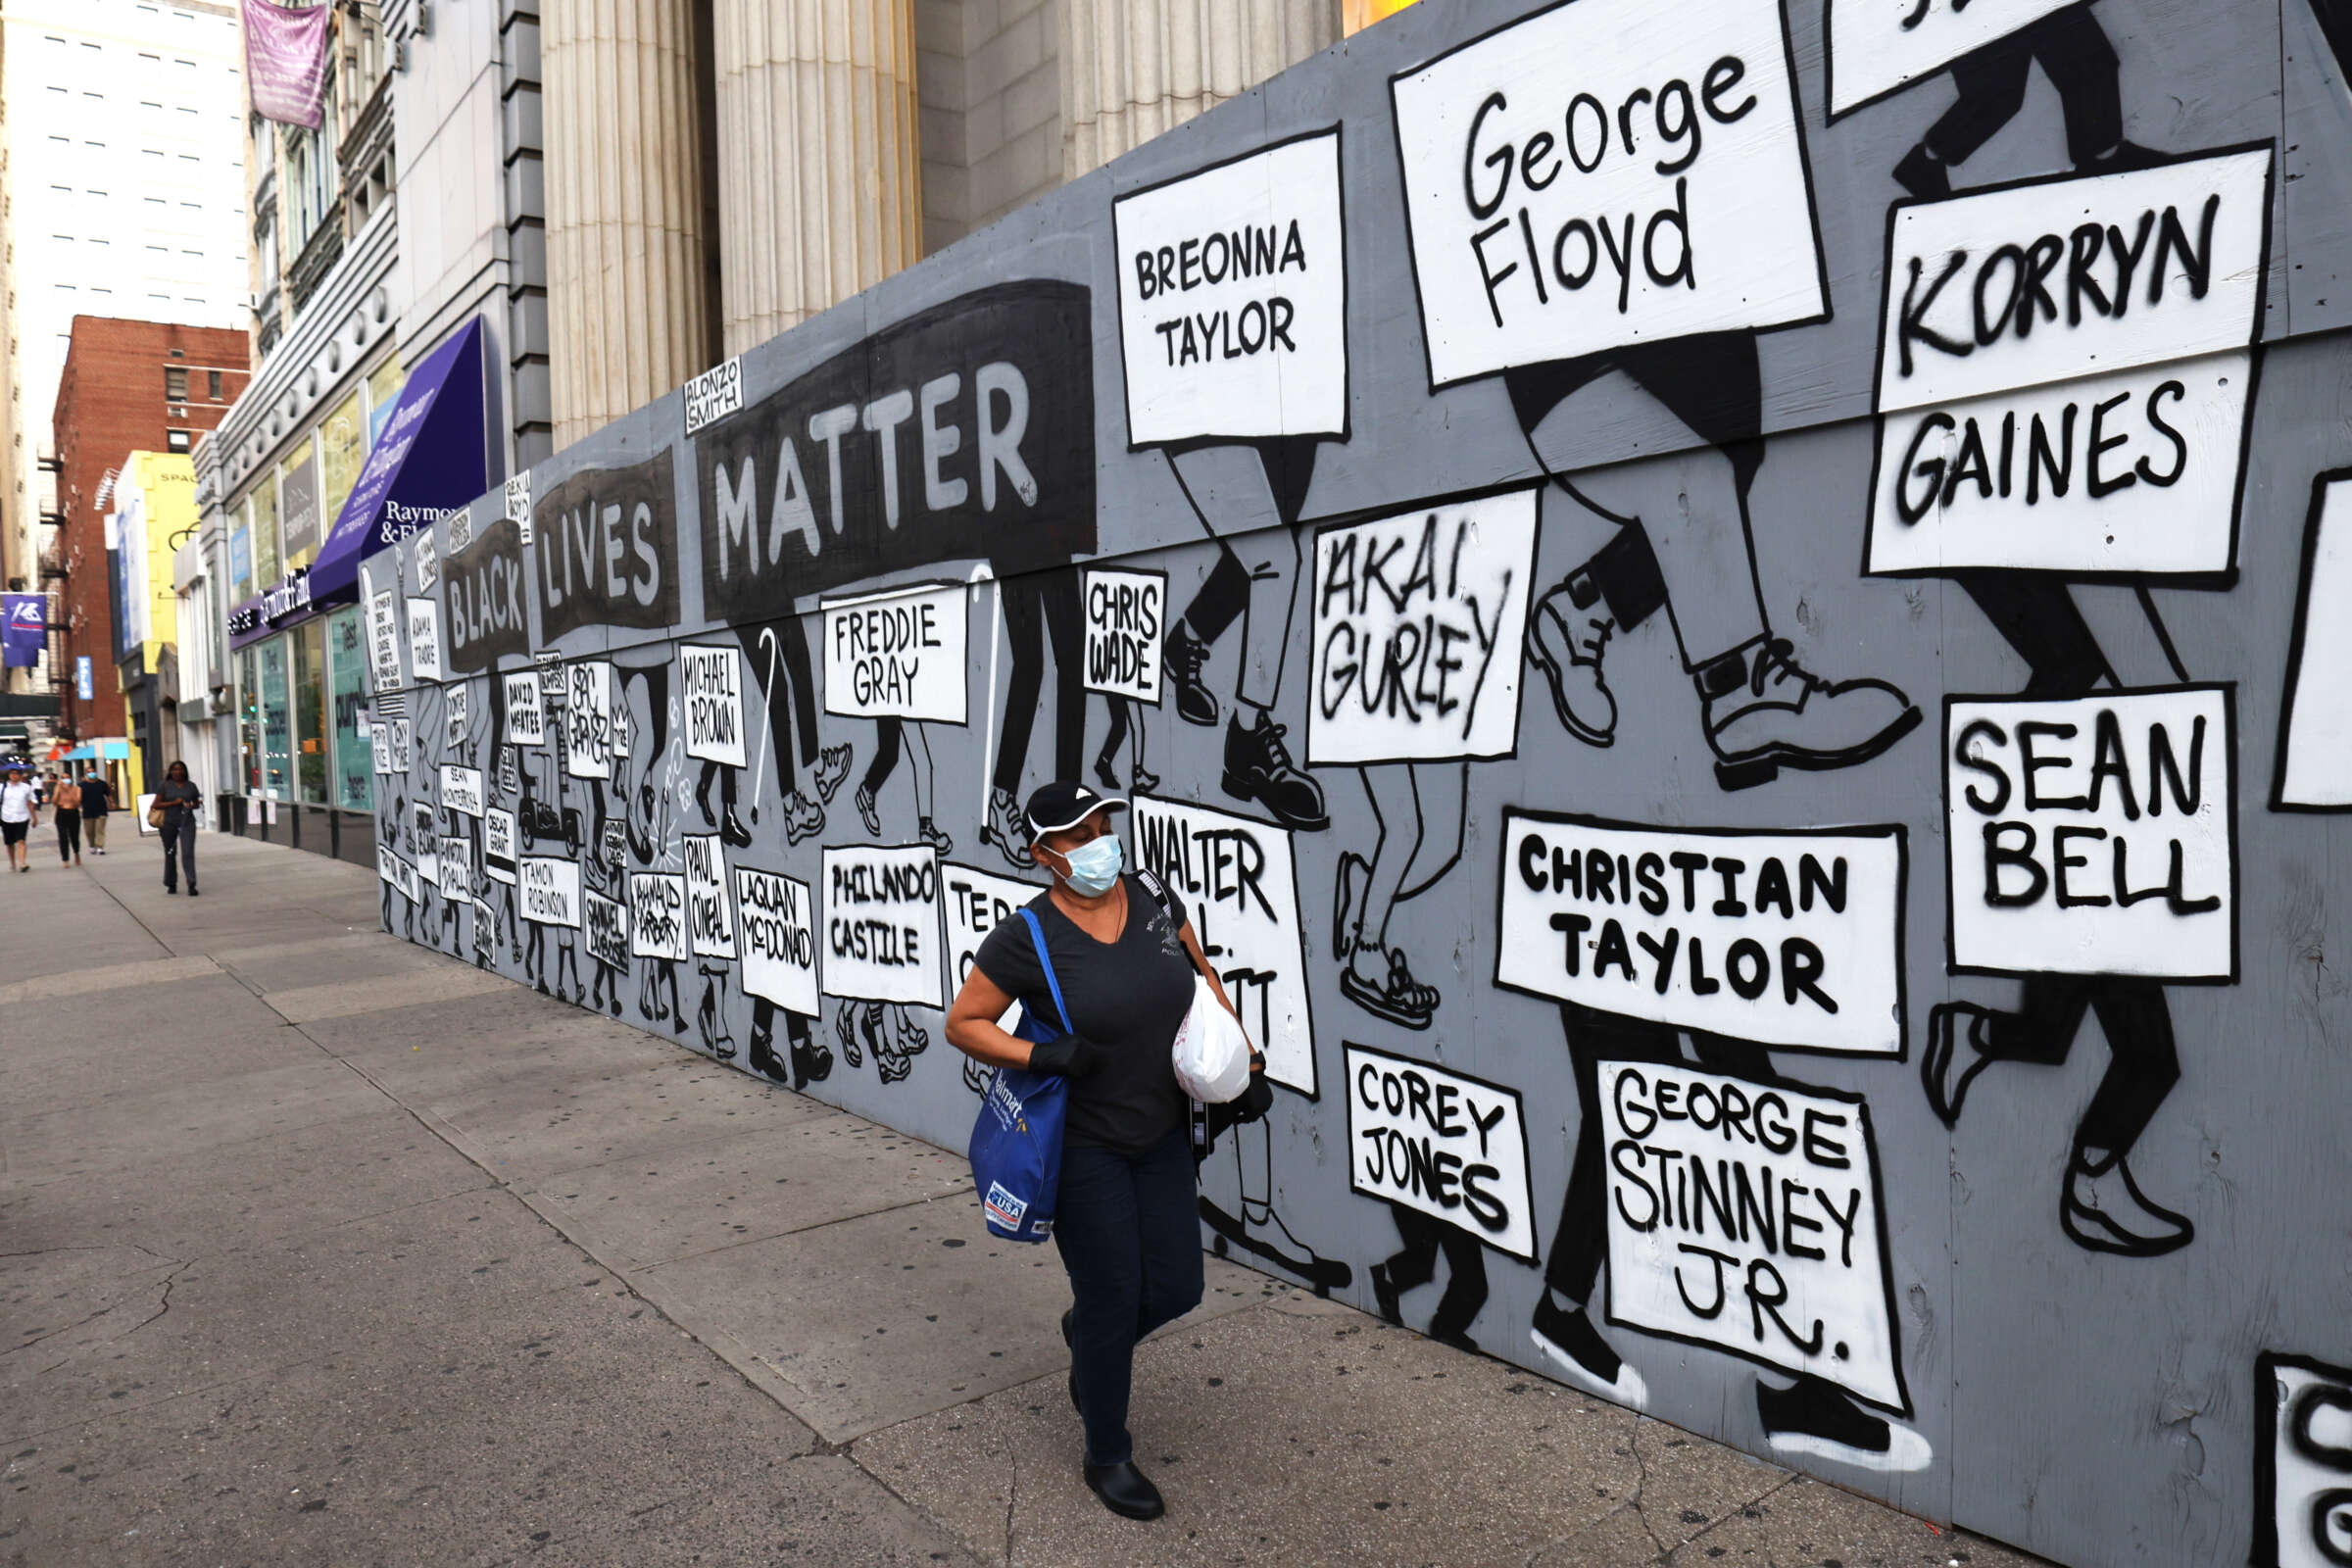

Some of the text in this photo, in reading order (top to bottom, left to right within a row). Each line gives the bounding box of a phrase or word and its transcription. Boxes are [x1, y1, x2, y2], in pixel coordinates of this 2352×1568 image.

[1463, 55, 1757, 220] George
[1136, 218, 1307, 301] BREONNA
[1471, 176, 1696, 327] Floyd
[1899, 193, 2221, 378] KORRYN
[1155, 297, 1296, 368] TAYLOR
[687, 362, 737, 407] ALONZO
[688, 386, 737, 429] SMITH
[714, 361, 1038, 583] MATTER
[1895, 379, 2185, 527] GAINES
[385, 501, 457, 524] Raymo
[543, 500, 660, 608] LIVES
[1322, 514, 1470, 617] AKAI
[450, 555, 522, 649] BLACK
[1088, 582, 1158, 641] CHRIS
[836, 604, 941, 662] FREDDIE
[1089, 631, 1152, 690] WADE
[1319, 568, 1512, 741] GURLEY
[509, 682, 533, 708] DAVID
[683, 651, 735, 699] MICHAEL
[853, 655, 919, 708] GRAY
[691, 697, 735, 746] BROWN
[451, 767, 468, 783] SEAN
[1955, 708, 2208, 822] SEAN
[488, 814, 508, 838] OSCAR
[490, 834, 509, 856] GRANT
[522, 862, 554, 886] TAMON
[686, 838, 719, 886] PAUL
[832, 860, 935, 908] PHILANDO
[1139, 809, 1278, 924] WALTER
[1519, 834, 1847, 919] CHRISTIAN
[1983, 821, 2221, 918] BELL
[528, 887, 567, 921] ROBINSON
[587, 898, 624, 939] SAMUEL
[693, 890, 731, 947] O'NEAL
[738, 871, 796, 924] LAQUAN
[950, 881, 1025, 933] TE
[830, 918, 919, 966] CASTILE
[1198, 903, 1233, 958] L.
[1548, 912, 1839, 1013] TAYLOR
[1357, 1062, 1505, 1158] COREY
[1615, 1067, 1851, 1170] GEORGE
[998, 1197, 1019, 1217] USA
[1362, 1128, 1509, 1233] JONES
[1610, 1140, 1862, 1268] STINNEY
[1674, 1242, 1849, 1360] JR.
